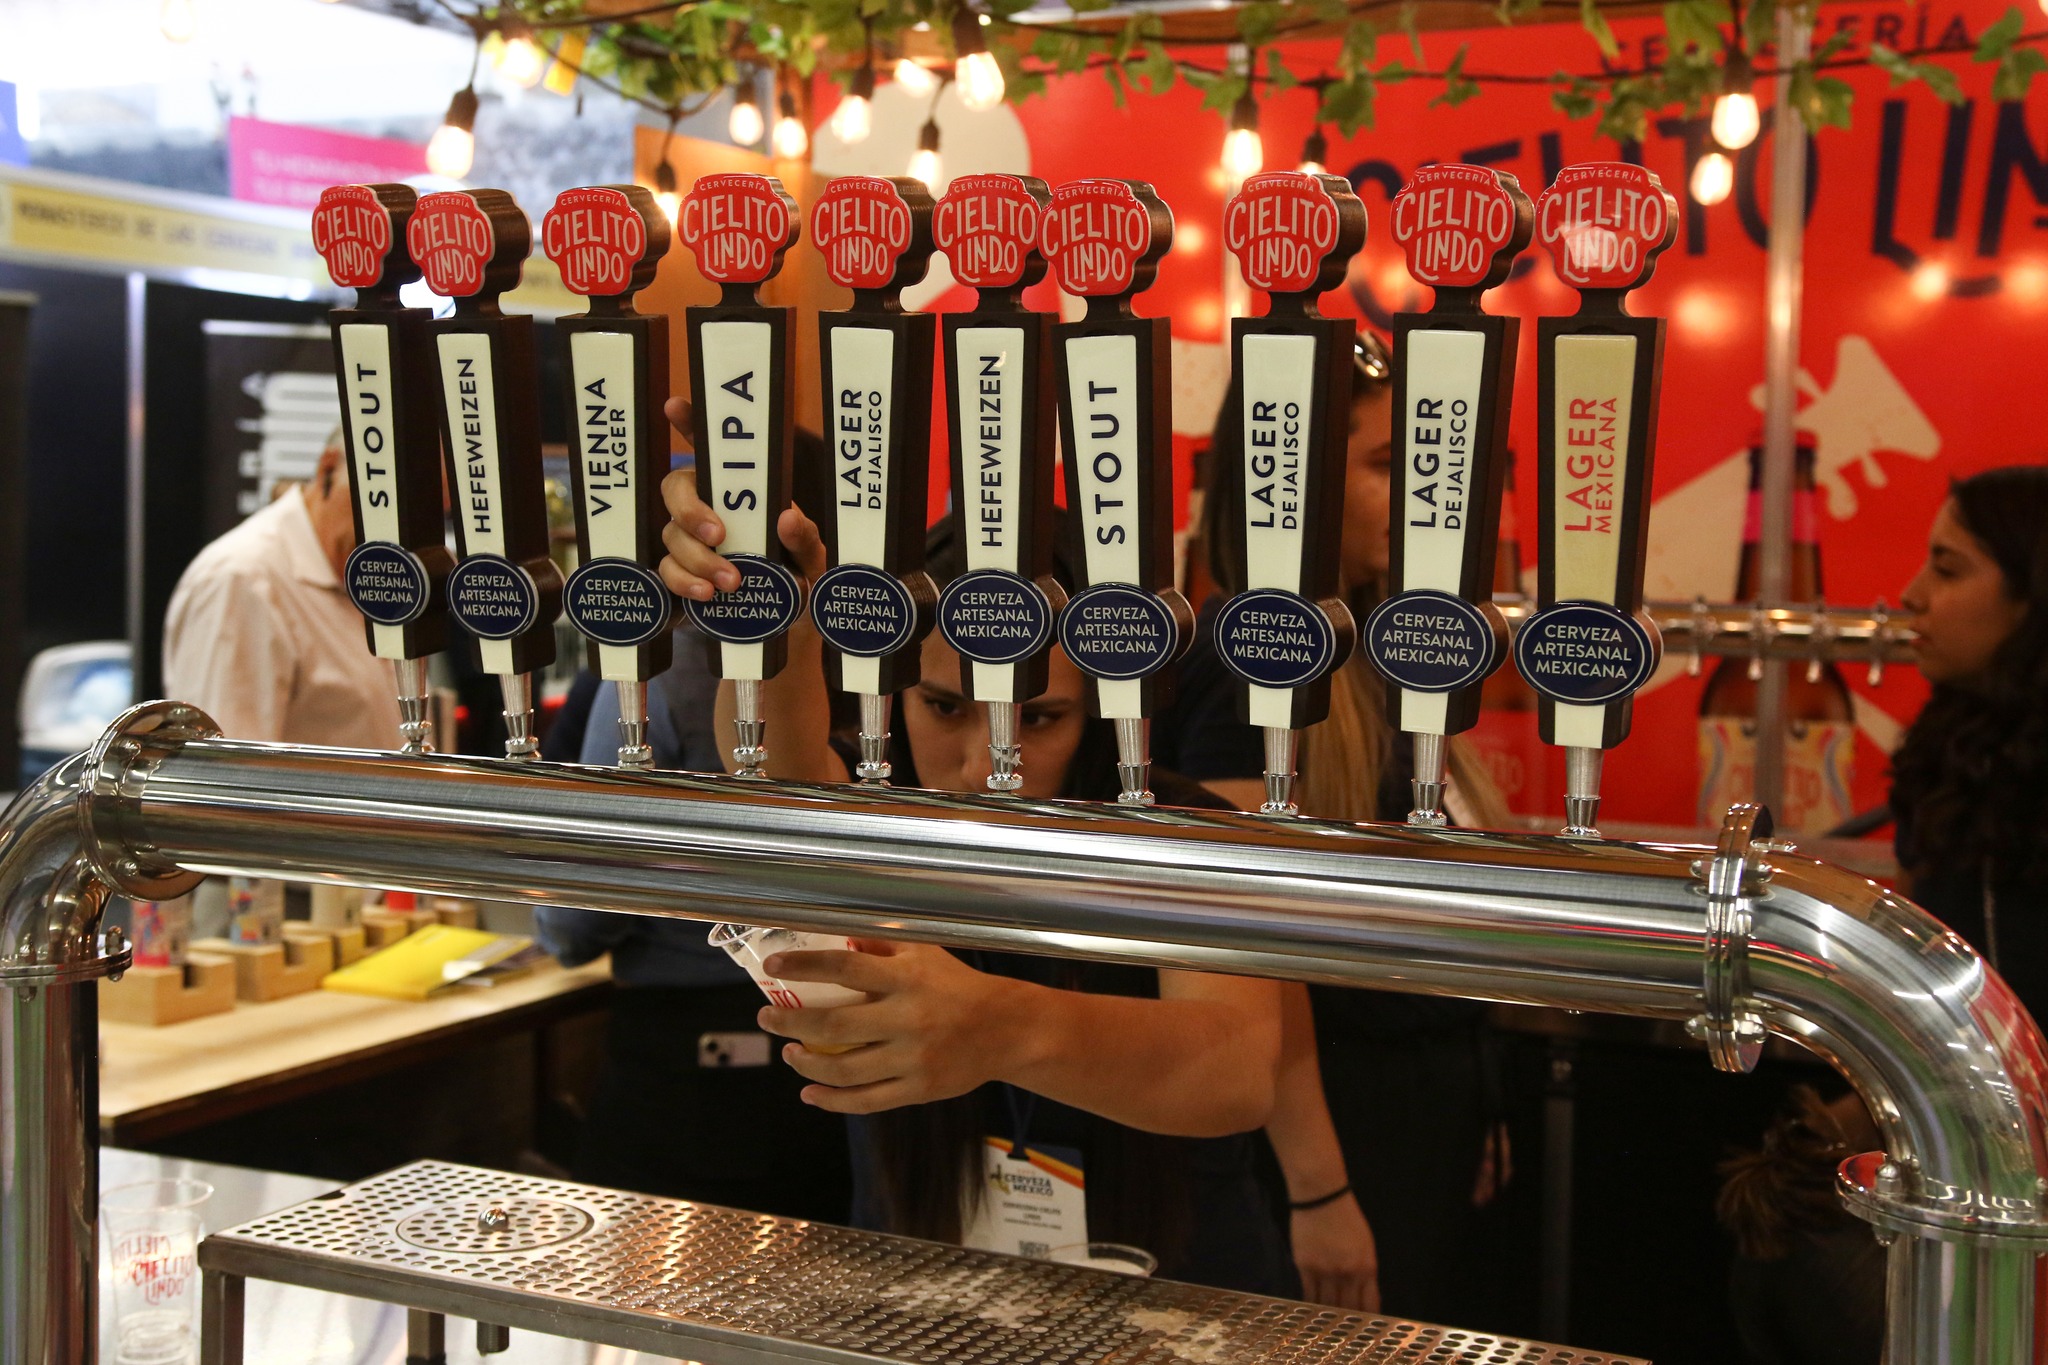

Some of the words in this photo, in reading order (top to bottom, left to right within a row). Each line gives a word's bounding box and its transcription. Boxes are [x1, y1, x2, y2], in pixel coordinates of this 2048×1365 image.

[699, 179, 766, 192] CERVECERÍA
[953, 179, 1020, 194] CERVECERÍA
[1247, 179, 1315, 193] CERVECERÍA
[1418, 169, 1492, 185] CERVECERÍA
[1563, 169, 1643, 183] CERVECERÍA
[323, 190, 371, 204] CERVECERÍA
[829, 181, 890, 196] CERVECERÍA
[1058, 185, 1125, 201] CERVECERÍA
[419, 196, 471, 210] CERVECERÍA
[560, 194, 622, 207] CERVECERÍA
[683, 193, 785, 243] CIELITO
[814, 197, 906, 248] CIELITO
[937, 195, 1037, 248] CIELITO
[1229, 195, 1333, 250] CIELITO
[1395, 187, 1509, 243] CIELITO
[1541, 186, 1662, 244] CIELITO
[314, 206, 386, 252] CIELITO
[410, 212, 488, 261] CIELITO
[546, 208, 640, 257] CIELITO
[1042, 201, 1145, 257] CIELITO
[330, 241, 375, 285] LINDO
[703, 232, 767, 279] LINDO
[832, 236, 889, 284] LINDO
[957, 235, 1019, 283] LINDO
[1248, 236, 1312, 288] LINDO
[1414, 229, 1484, 281] LINDO
[1563, 227, 1637, 283] LINDO
[427, 249, 477, 293] LINDO
[566, 246, 625, 292] LINDO
[1063, 242, 1127, 292] LINDO
[357, 363, 389, 508] STOUT
[720, 370, 756, 511] SIPA
[868, 391, 882, 478] JALISCO
[457, 358, 491, 533] HEFEWEIZEN
[584, 377, 612, 516] VIENNA
[609, 408, 629, 488] LAGER
[840, 388, 862, 508] LAGER
[979, 356, 1002, 547] HEFEWEIZEN
[1282, 402, 1300, 497] JALISCO
[1446, 399, 1468, 496] JALISCO
[1088, 380, 1126, 545] STOUT
[1250, 401, 1277, 528] LAGER
[1410, 398, 1443, 528] LAGER
[1564, 398, 1597, 532] LAGER
[1594, 397, 1617, 534] MEXICANA
[868, 483, 882, 510] DE
[1282, 501, 1297, 529] DE
[1444, 500, 1462, 530] DE
[359, 561, 407, 574] CERVEZA
[355, 575, 414, 589] ARTESANAL
[463, 575, 514, 588] CERVEZA
[585, 579, 645, 593] CERVEZA
[740, 576, 774, 589] VEZA
[358, 590, 413, 604] MEXICANA
[458, 590, 522, 603] ARTESANAL
[577, 594, 654, 609] ARTESANAL
[711, 591, 783, 604] RTESANAL
[831, 585, 890, 602] CERVEZA
[960, 592, 1025, 606] CERVEZA
[462, 605, 522, 618] MEXICANA
[581, 610, 652, 624] MEXICANA
[703, 606, 781, 620] MEXICANA
[823, 601, 898, 619] ARTESANAL
[951, 609, 1034, 622] ARTESANAL
[1082, 607, 1150, 620] CERVEZA
[1239, 610, 1307, 629] CERVEZA
[826, 617, 896, 634] MEXICANA
[955, 625, 1032, 638] MEXICANA
[1074, 624, 1159, 637] ARTESANAL
[1392, 612, 1466, 632] CERVEZA
[1230, 627, 1316, 647] ARTESANAL
[1381, 629, 1474, 650] ARTESANAL
[1544, 624, 1623, 643] CERVEZA
[1078, 640, 1158, 654] MEXICANA
[1233, 645, 1312, 664] MEXICANA
[1384, 646, 1470, 668] MEXICANA
[1532, 641, 1632, 662] ARTESANAL
[1535, 660, 1628, 679] MEXICANA
